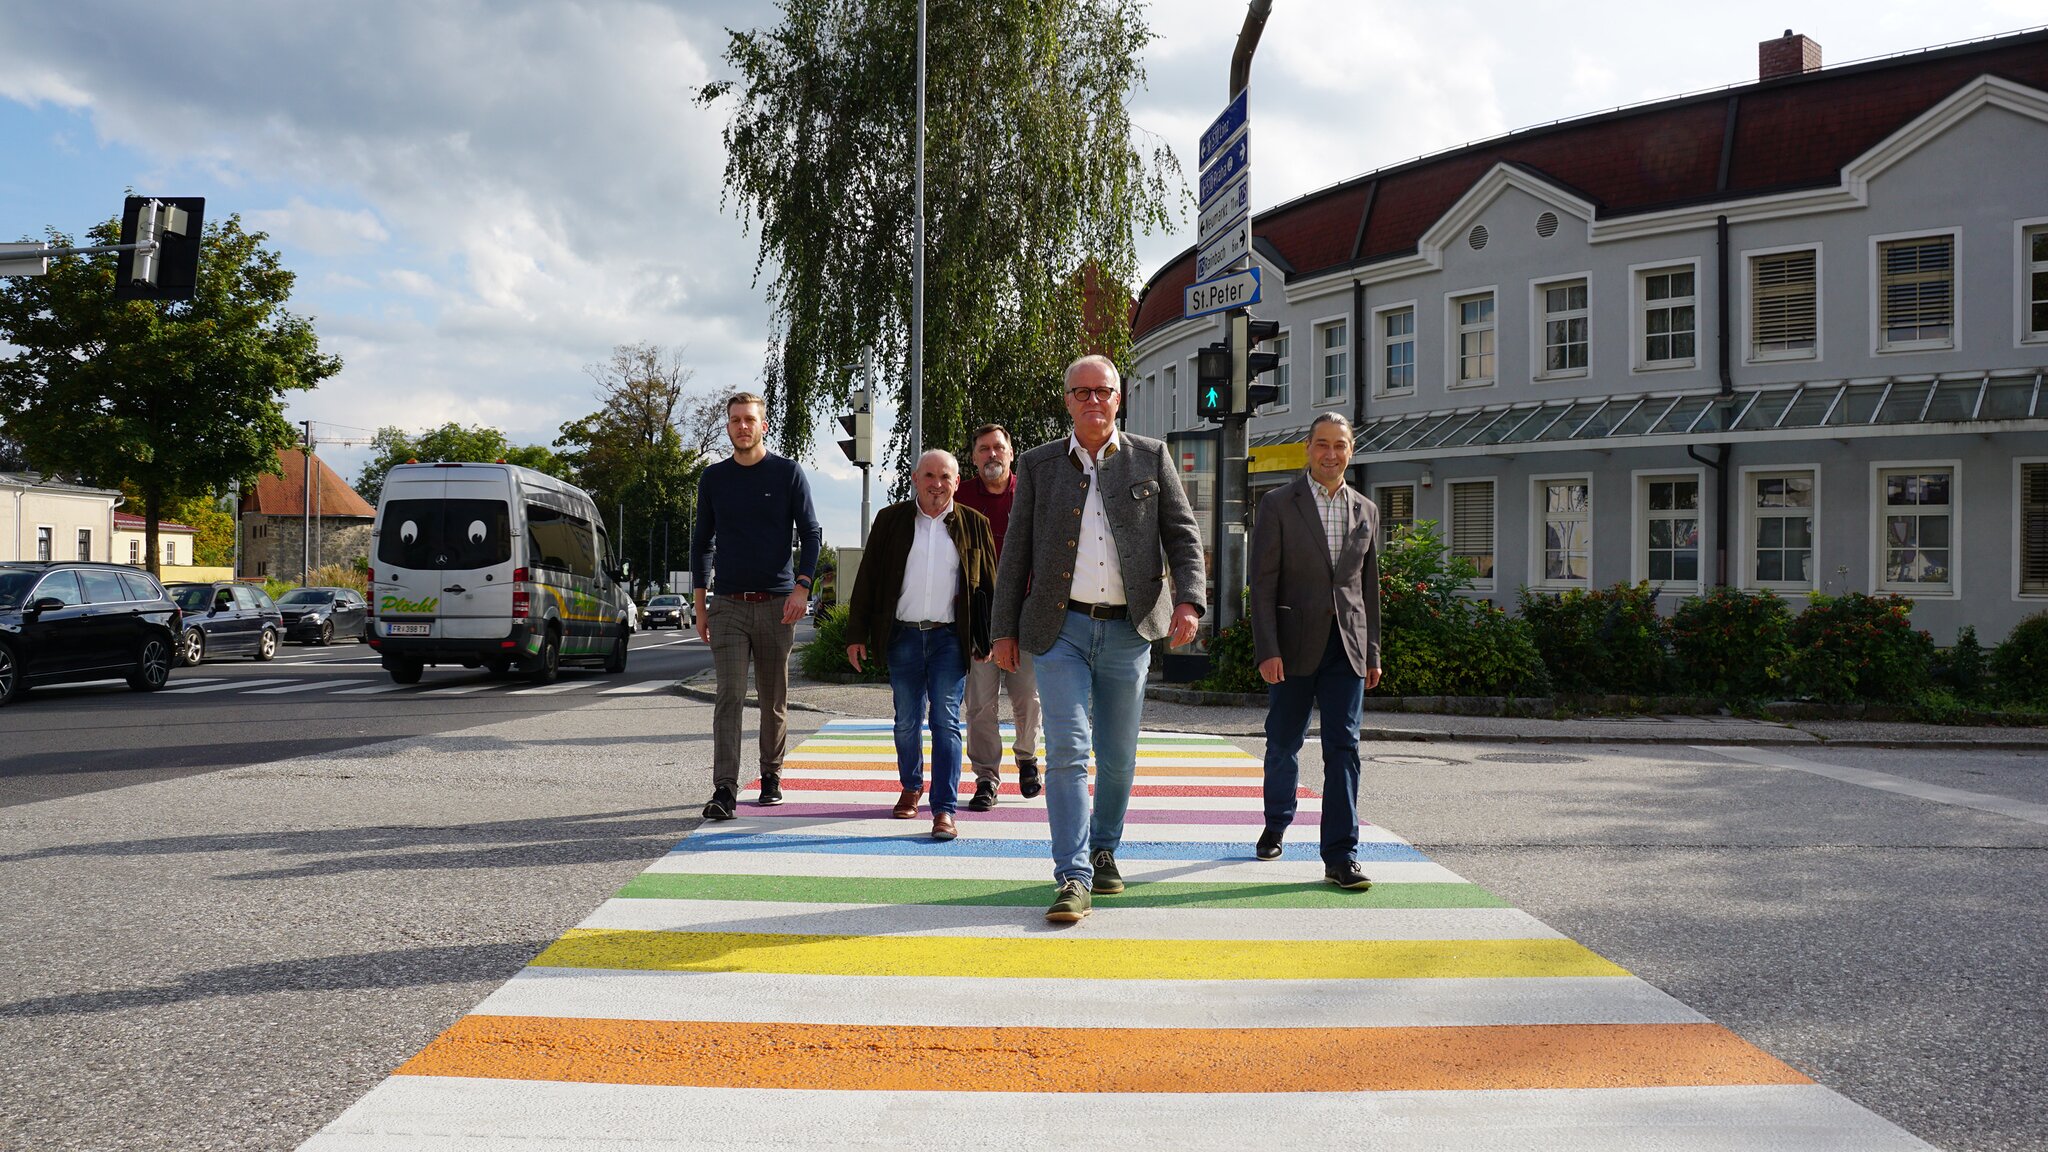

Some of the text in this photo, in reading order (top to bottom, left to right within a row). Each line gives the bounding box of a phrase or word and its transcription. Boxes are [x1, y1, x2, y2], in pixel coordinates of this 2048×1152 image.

[1205, 203, 1228, 233] Neumarkt
[1193, 283, 1244, 311] St.Peter
[380, 595, 439, 615] Plöchl
[392, 625, 401, 633] FR
